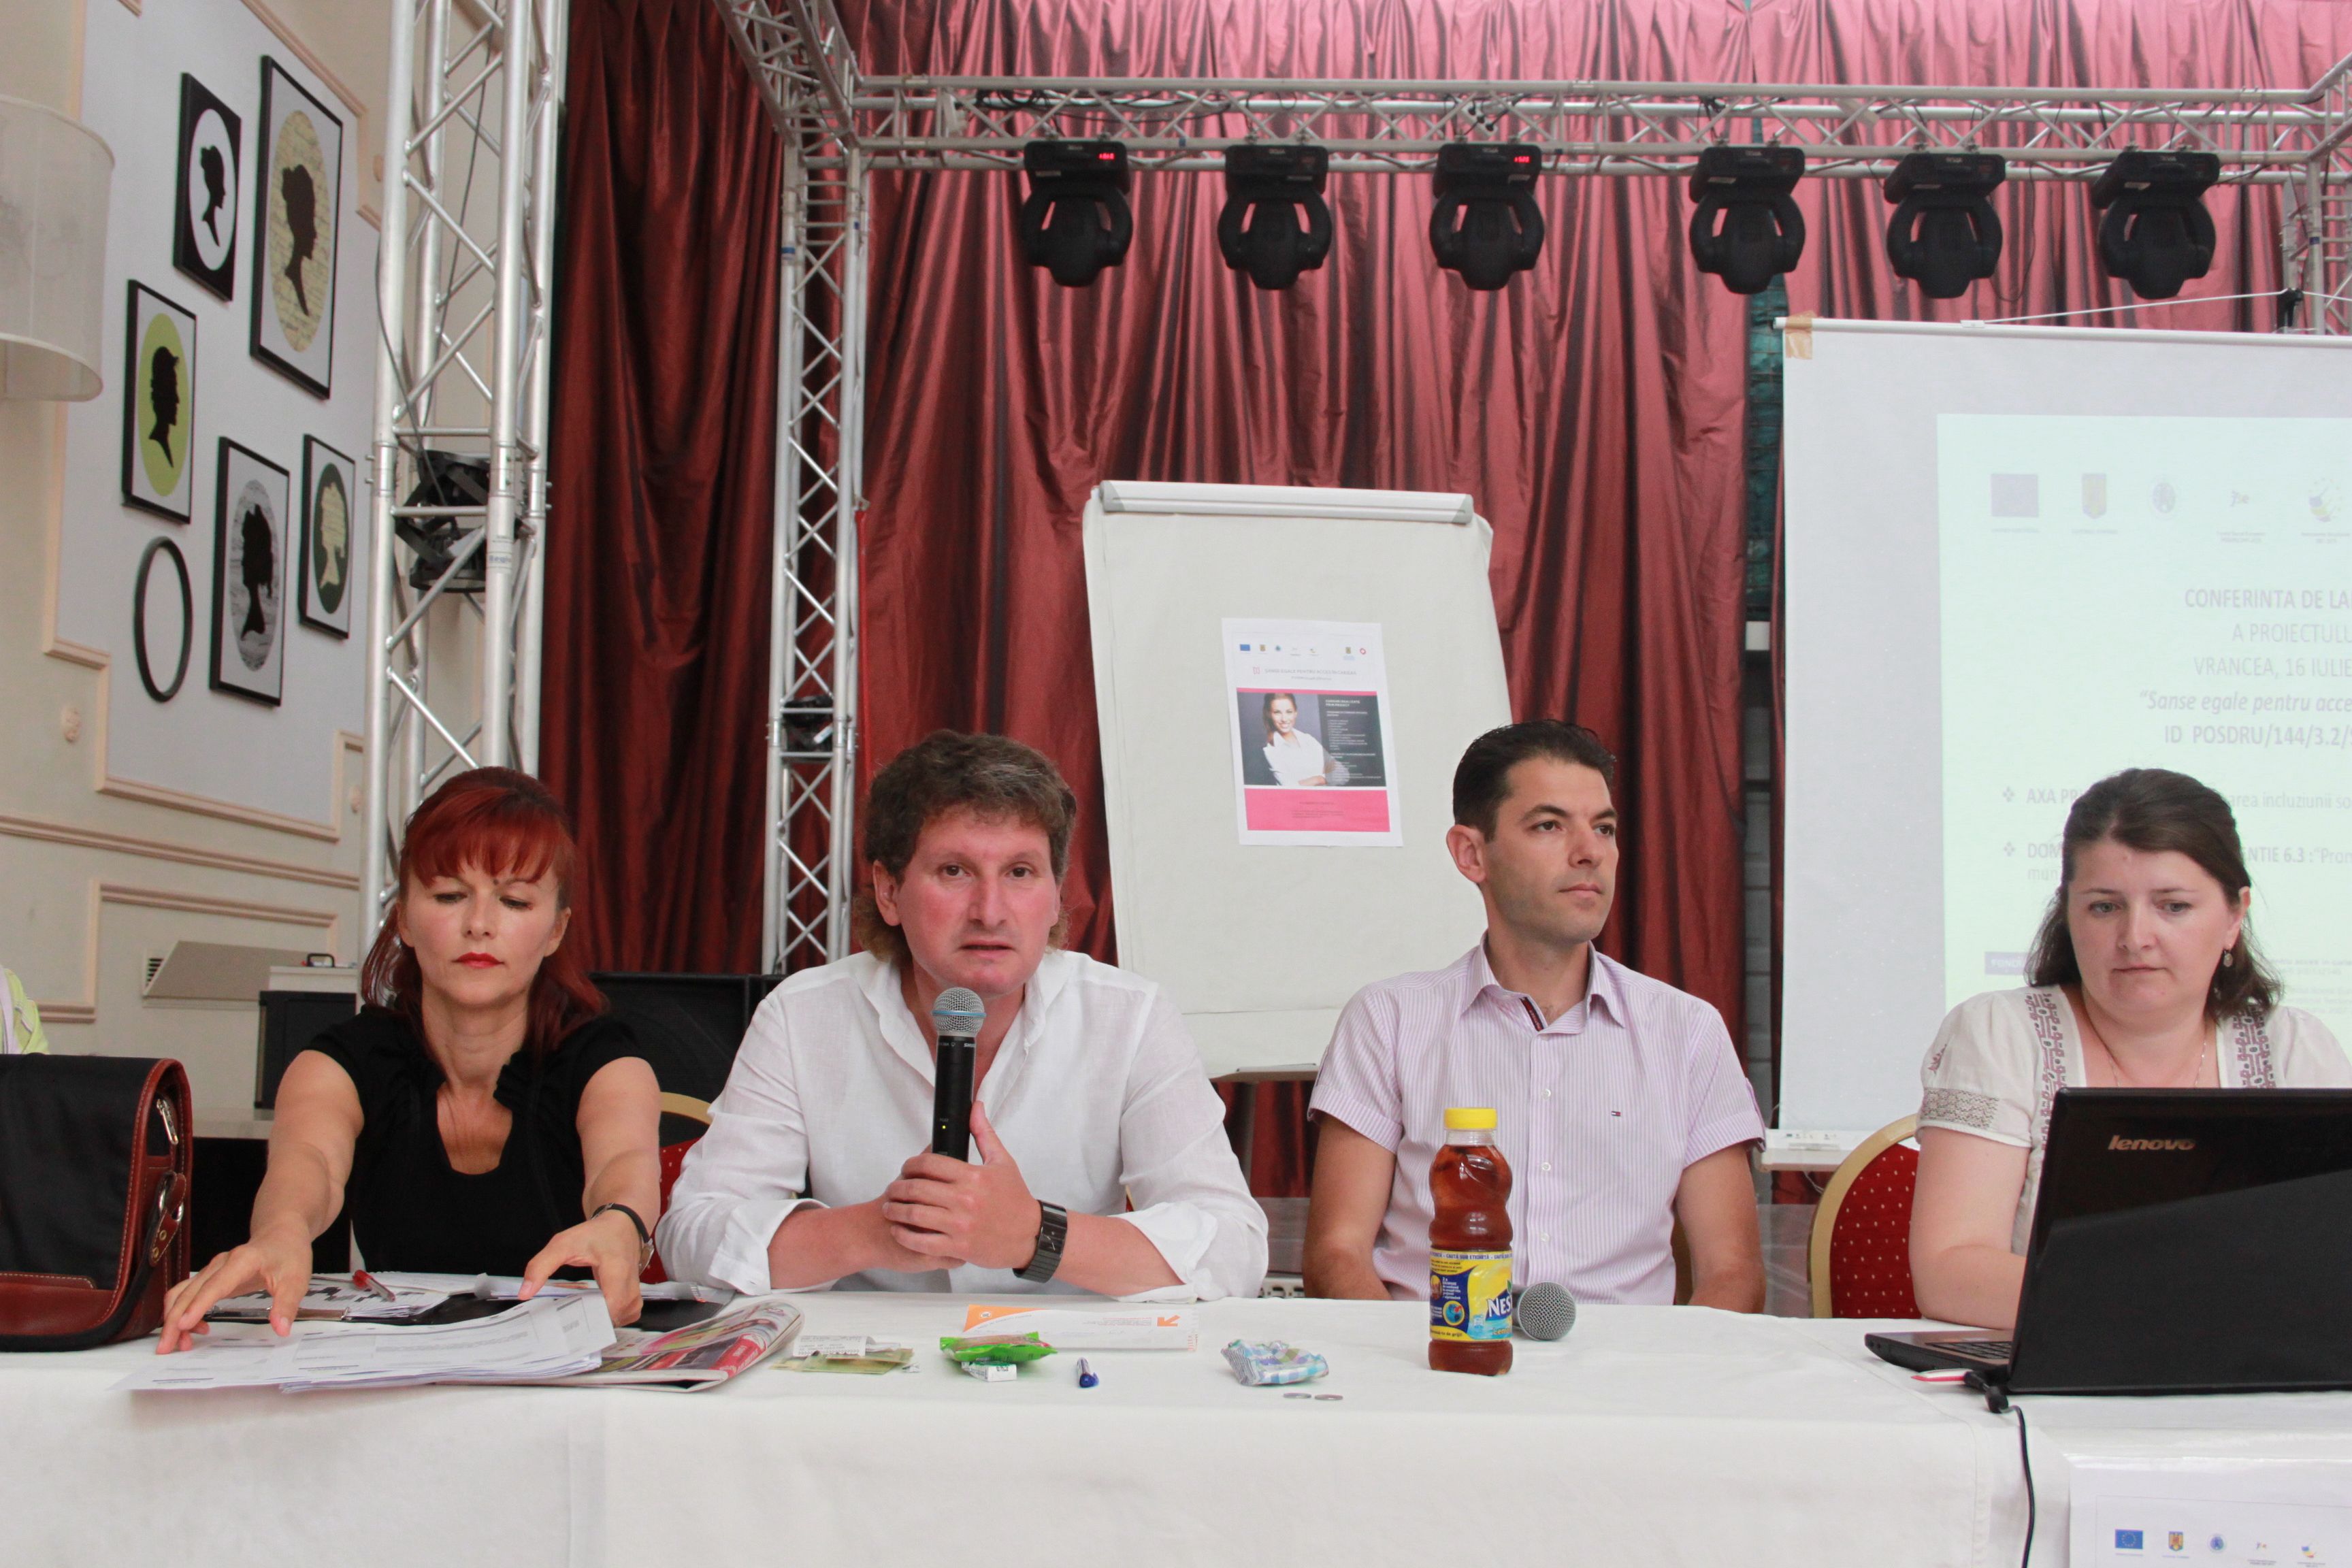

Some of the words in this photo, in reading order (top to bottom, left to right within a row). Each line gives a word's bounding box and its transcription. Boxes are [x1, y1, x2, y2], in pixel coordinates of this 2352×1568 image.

[2185, 588, 2296, 609] CONFERINTA
[2301, 589, 2323, 609] DE
[2329, 589, 2352, 609] LA
[2232, 623, 2244, 642] A
[2193, 657, 2280, 679] VRANCEA,
[2285, 658, 2306, 676] 16
[2311, 658, 2352, 678] IULIE
[2200, 691, 2247, 715] egale
[2251, 693, 2310, 715] pentru
[2164, 725, 2183, 744] ID
[2026, 788, 2057, 804] AXA
[2262, 791, 2332, 809] incluziunii
[2242, 847, 2279, 863] NTIE
[2283, 847, 2304, 863] 6.3
[2108, 1134, 2196, 1151] lenovo
